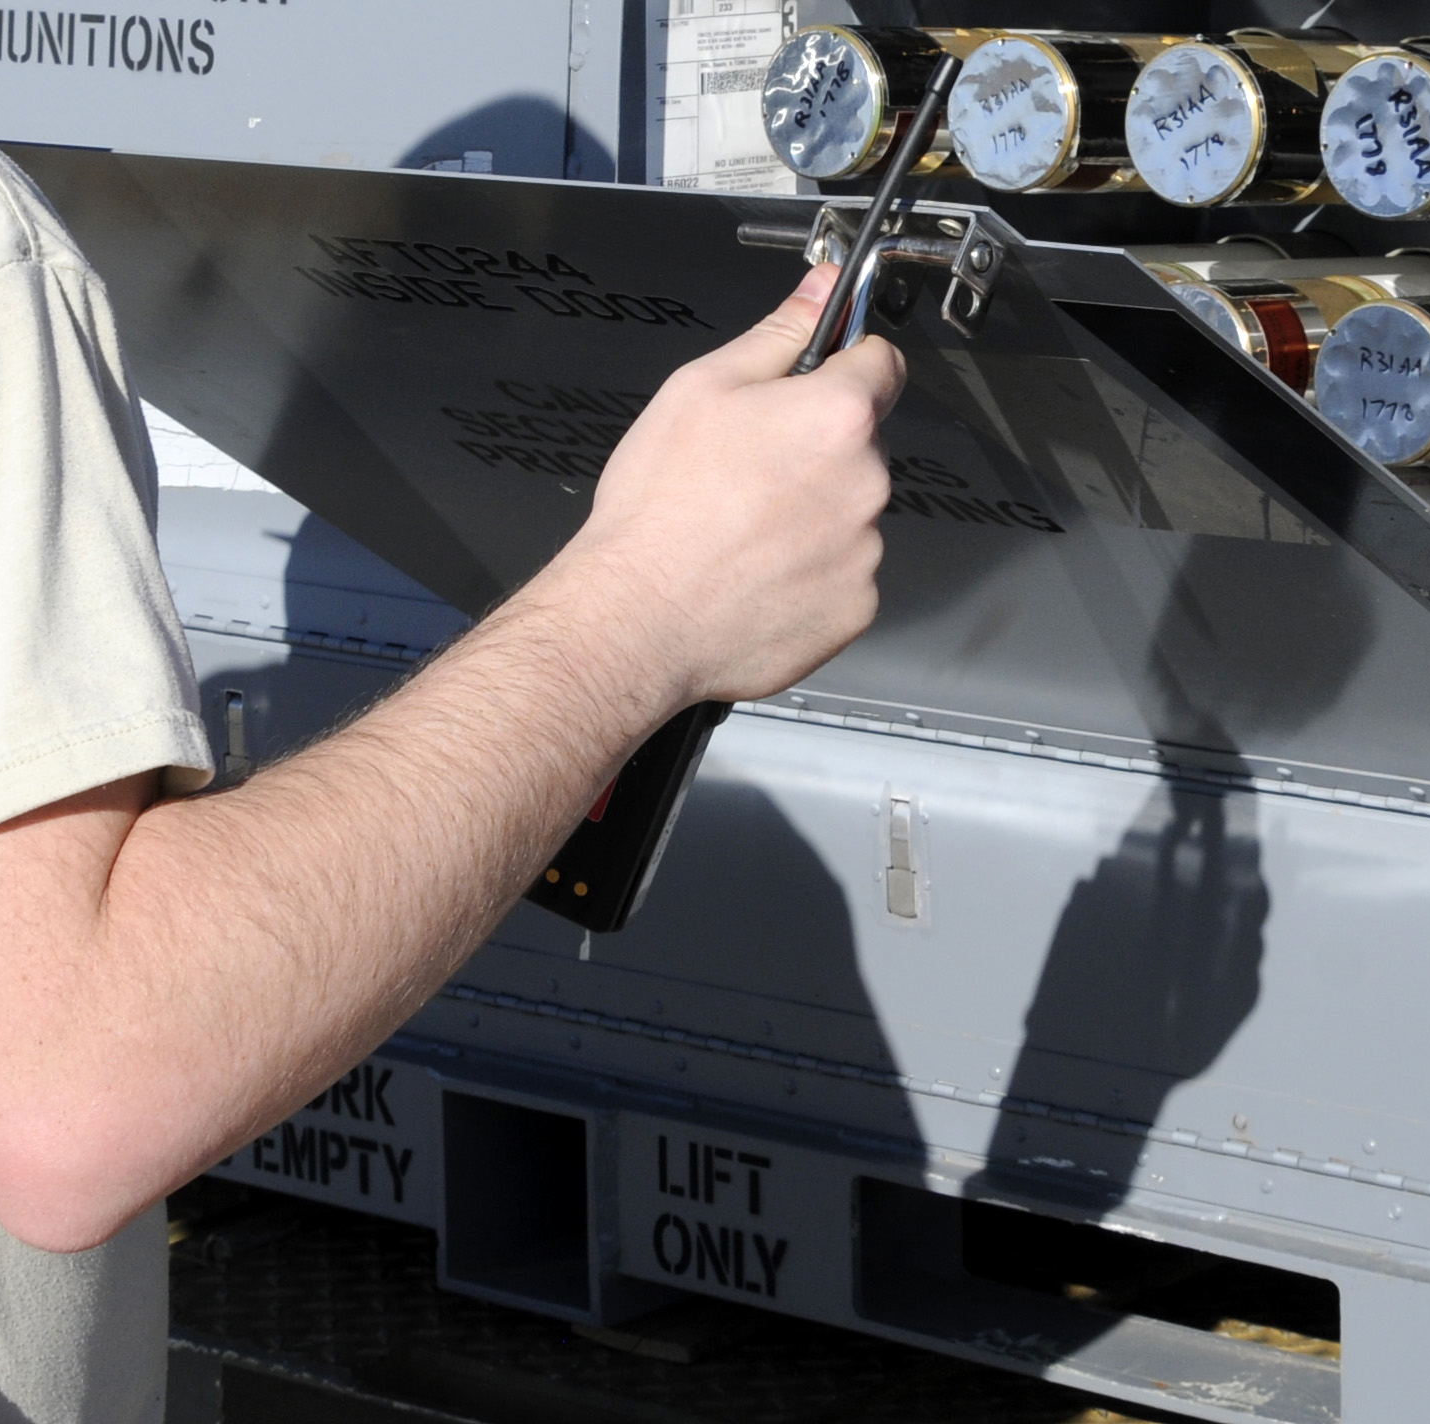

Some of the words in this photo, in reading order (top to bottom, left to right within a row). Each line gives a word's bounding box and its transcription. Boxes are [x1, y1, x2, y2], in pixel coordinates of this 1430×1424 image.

[794, 61, 828, 128] R31AA
[1154, 84, 1217, 141] R31AA
[293, 265, 516, 312] INSIDE
[514, 284, 717, 330] DOOR
[304, 1064, 395, 1126] RK
[253, 1121, 413, 1204] EMPTY
[656, 1135, 772, 1216] LIFT
[653, 1212, 789, 1299] ONLY
